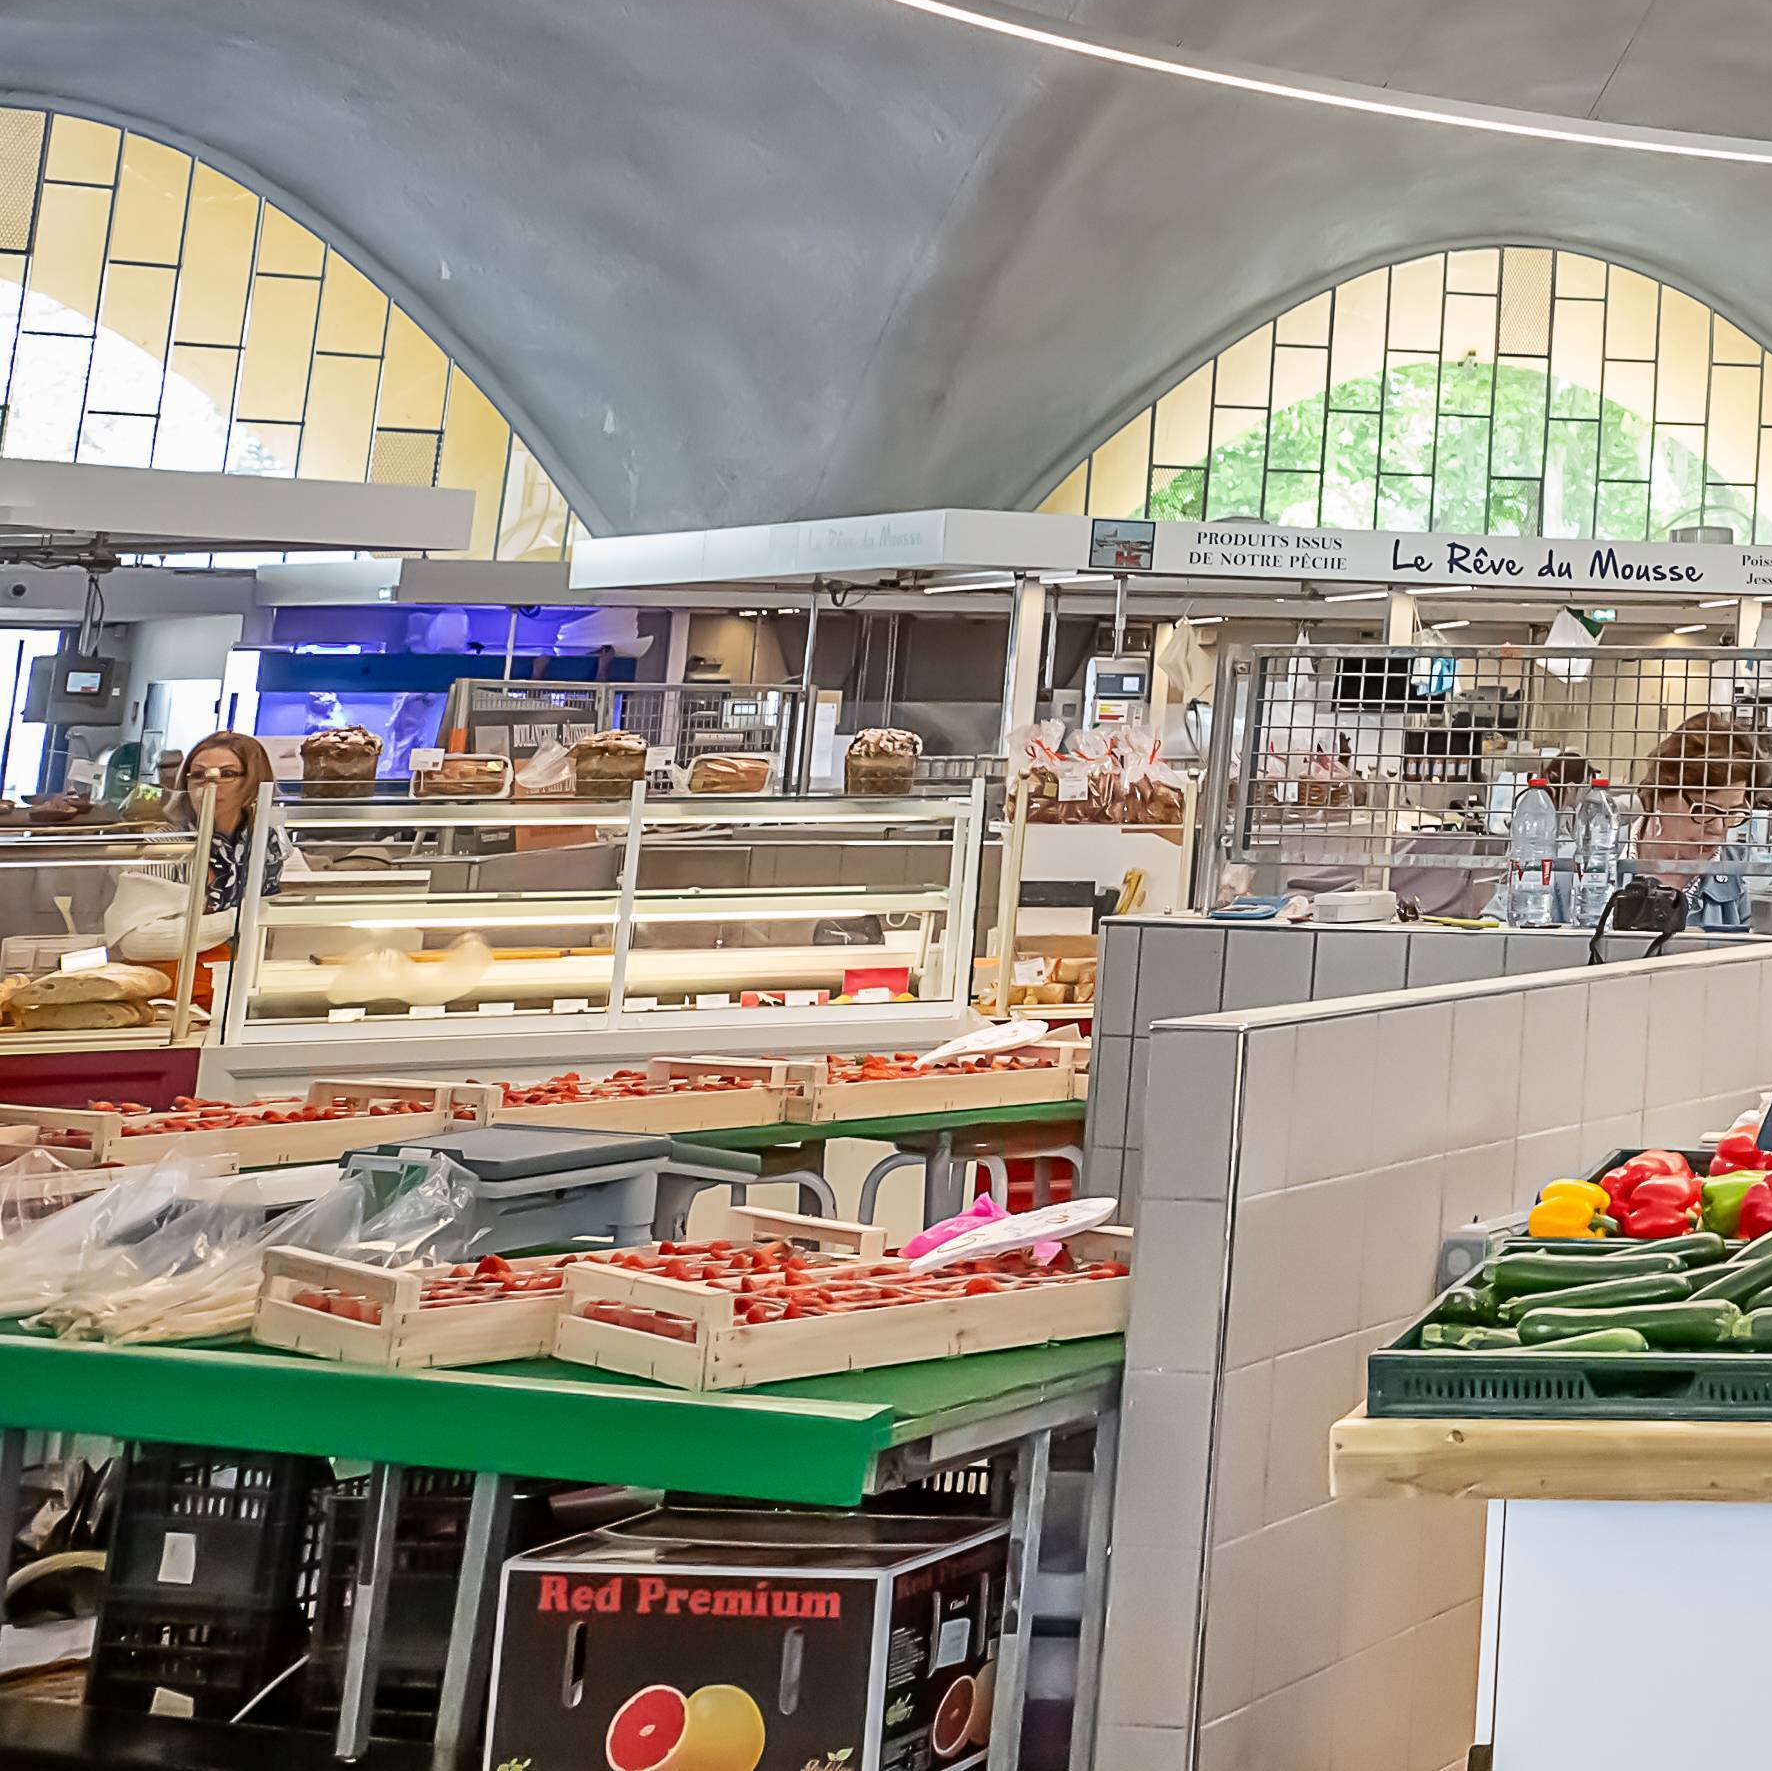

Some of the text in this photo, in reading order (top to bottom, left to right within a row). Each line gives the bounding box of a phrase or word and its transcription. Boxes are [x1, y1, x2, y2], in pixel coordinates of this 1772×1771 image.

[1197, 531, 1343, 550] PRODUITS ISSUS
[1189, 551, 1348, 571] DE NOTRE PÊCHE
[1393, 539, 1704, 583] Le Rêve du Mousse
[538, 1573, 841, 1619] Red Premium
